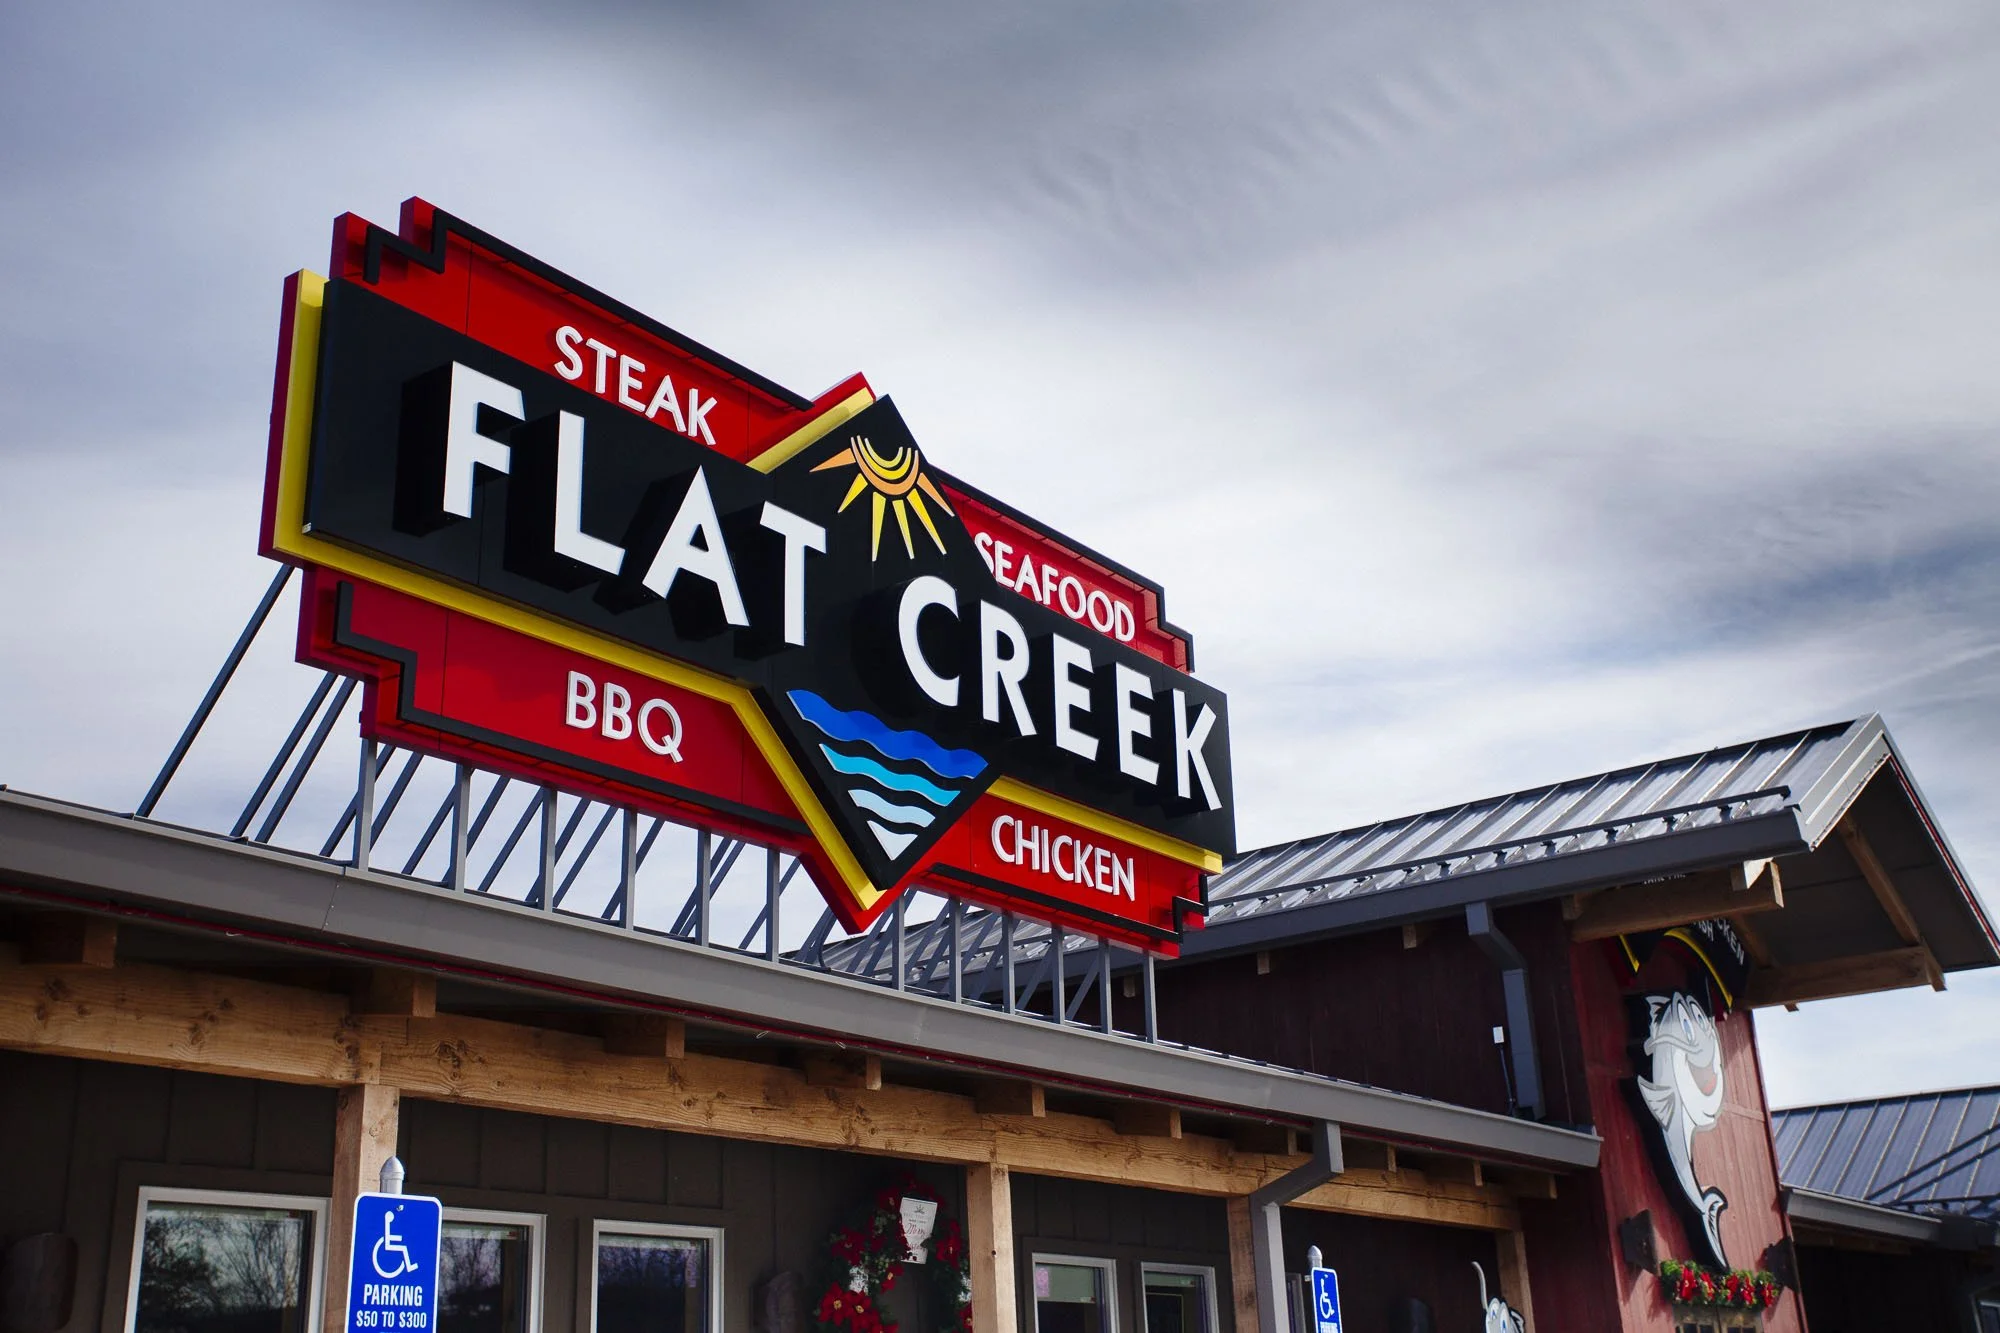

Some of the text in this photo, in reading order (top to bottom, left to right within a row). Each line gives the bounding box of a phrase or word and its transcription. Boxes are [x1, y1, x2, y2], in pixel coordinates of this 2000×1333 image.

[553, 325, 718, 446] STEAK
[443, 360, 1223, 812] FLAT CREEK
[974, 532, 1136, 642] SEAFOOD
[565, 670, 683, 763] BBQ
[991, 815, 1136, 901] CHICKEN
[356, 1310, 427, 1329] $50 TO $300
[363, 1284, 422, 1306] PARKING
